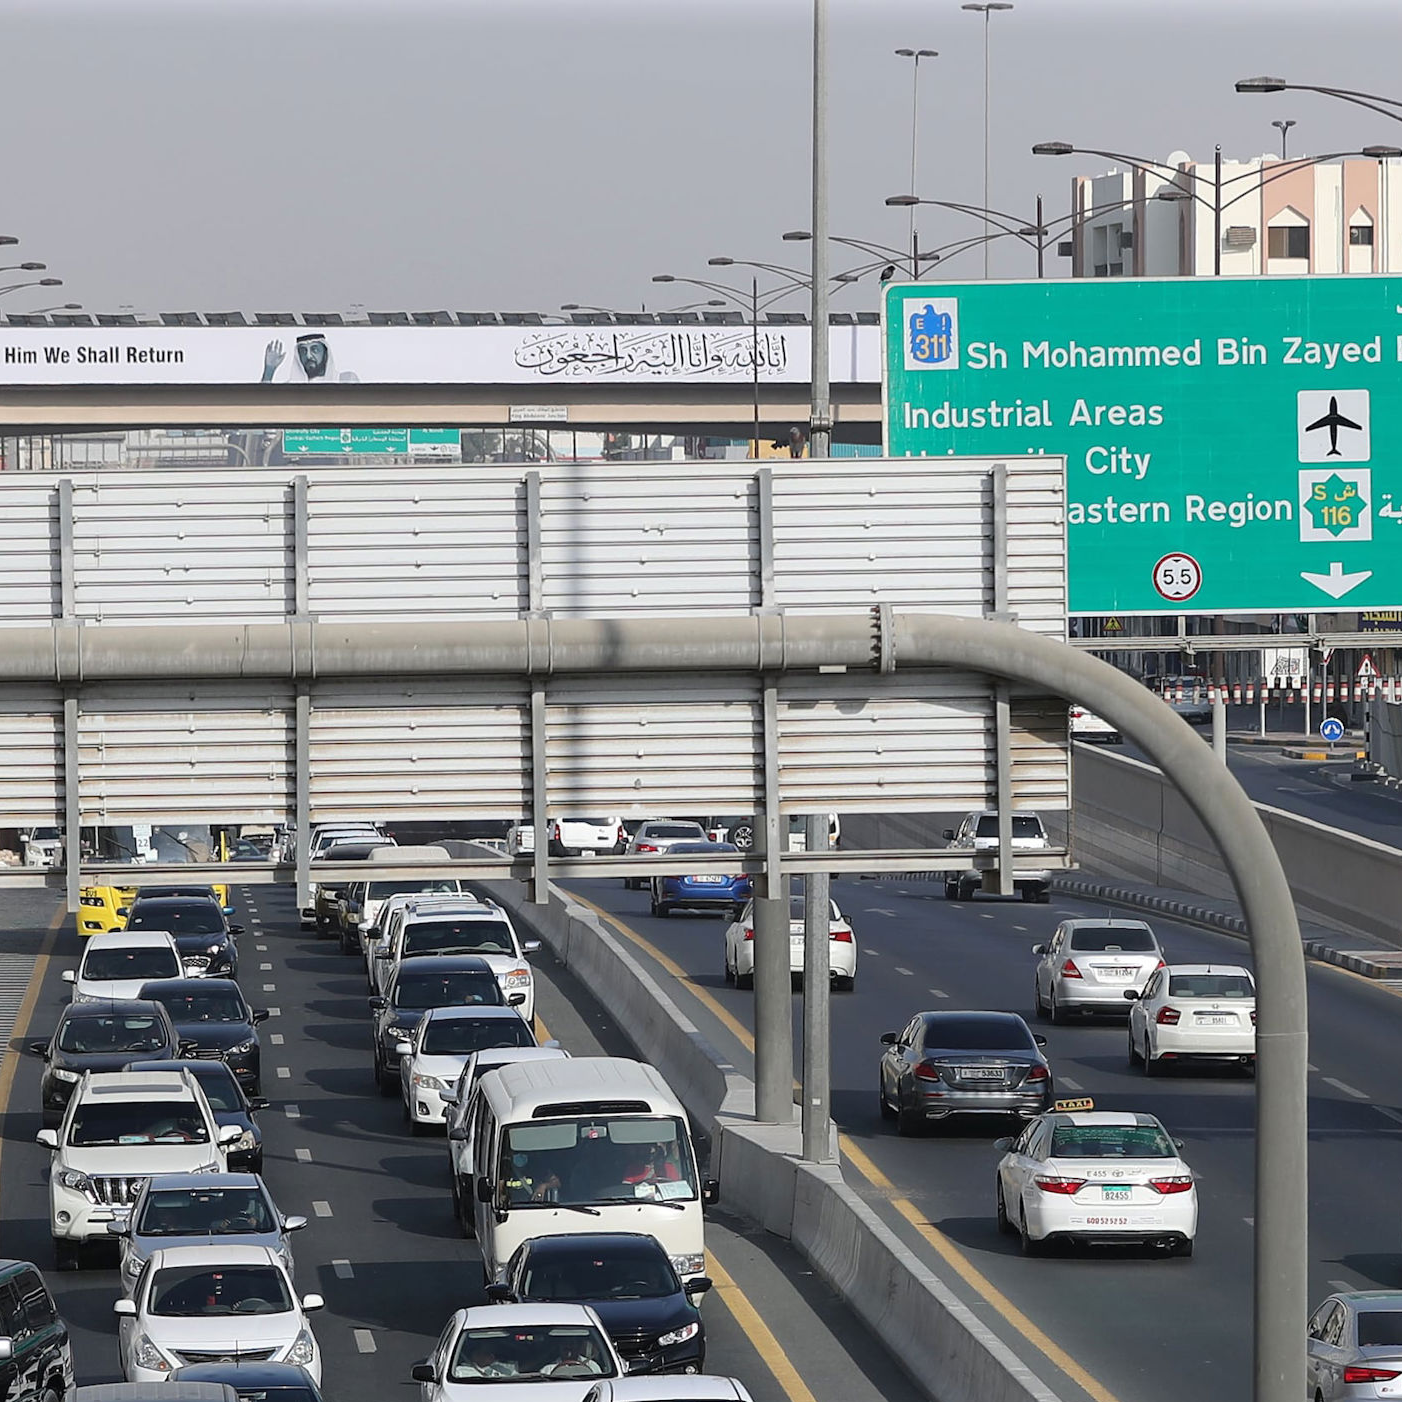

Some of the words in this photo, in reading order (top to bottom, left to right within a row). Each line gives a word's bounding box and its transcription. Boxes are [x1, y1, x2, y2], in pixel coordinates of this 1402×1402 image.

[5, 346, 38, 364] Him
[44, 346, 71, 364] We
[77, 346, 120, 364] Shall
[127, 346, 185, 364] Return
[915, 333, 949, 361] 311
[966, 341, 1008, 369] Sh
[1022, 338, 1201, 368] Mohammed
[1217, 337, 1268, 366] Bin
[1282, 335, 1382, 369] Zayed
[903, 400, 1053, 429] Industrial
[1068, 398, 1165, 427] Areas
[1085, 446, 1151, 480] City
[1068, 497, 1171, 525] astern
[1185, 494, 1294, 529] Region
[1321, 505, 1353, 528] 116
[1162, 567, 1193, 587] 5.5
[137, 838, 149, 848] 22
[1062, 1100, 1088, 1109] TAXI
[1093, 1170, 1108, 1178] 455
